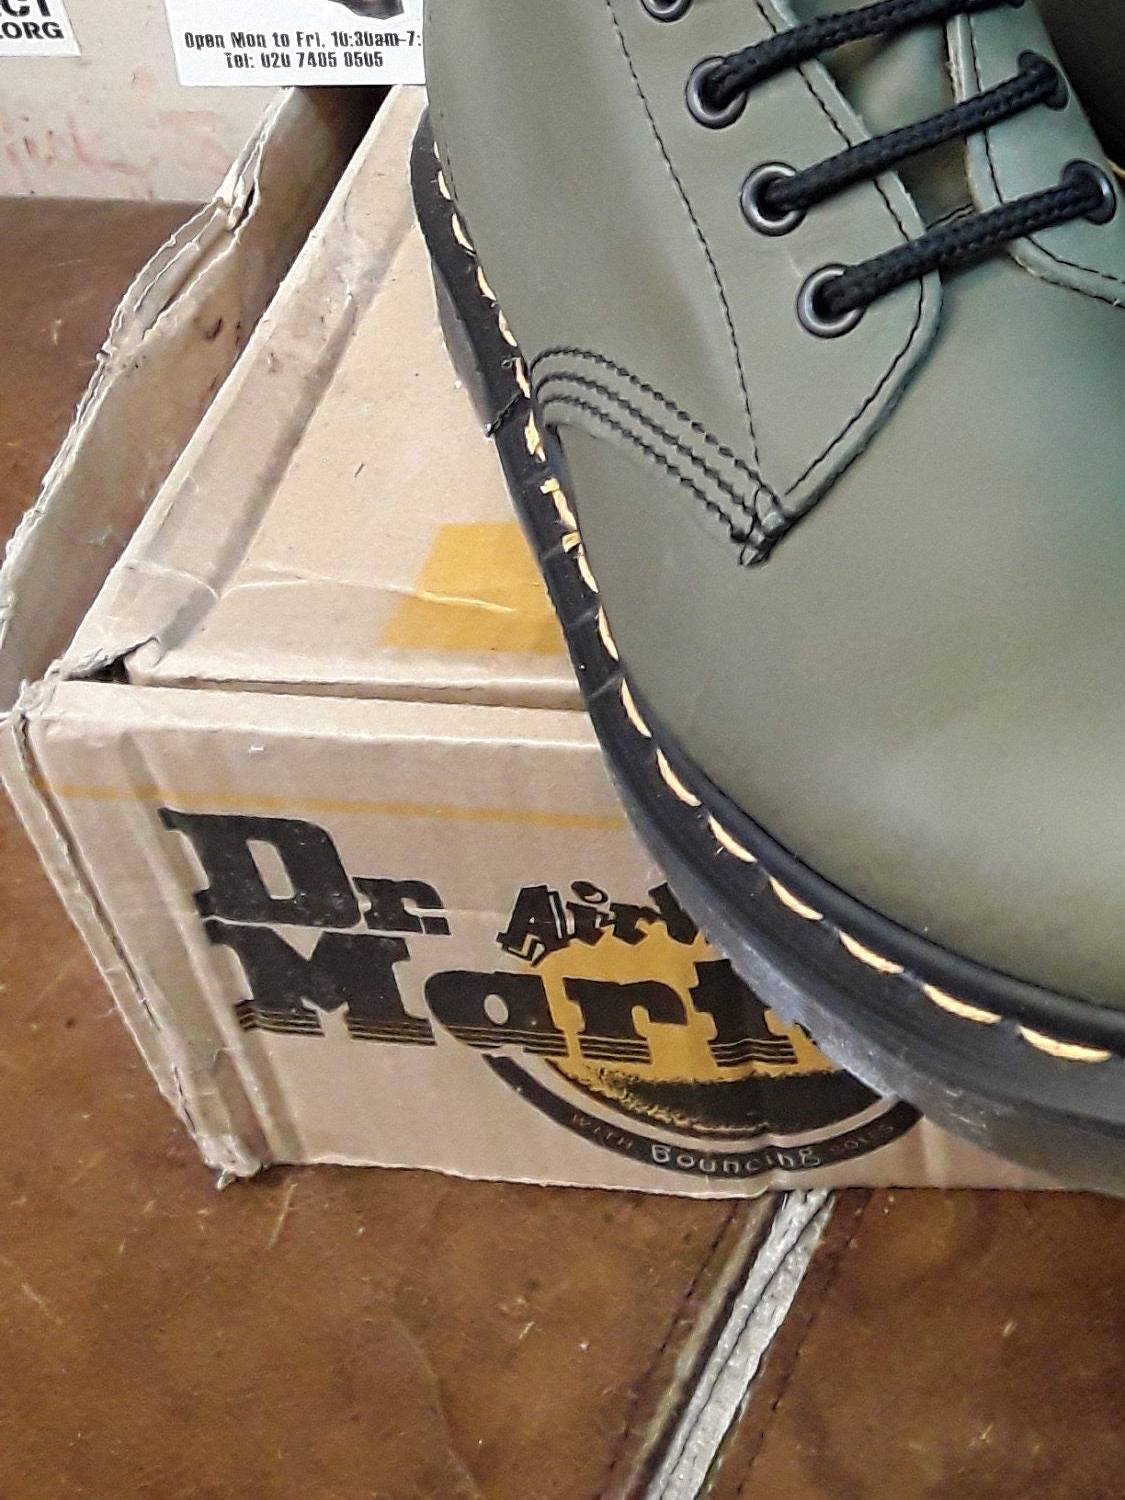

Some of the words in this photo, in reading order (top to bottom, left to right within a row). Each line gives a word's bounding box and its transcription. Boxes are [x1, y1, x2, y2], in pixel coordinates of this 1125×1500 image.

[184, 31, 226, 50] Open
[230, 31, 267, 48] Mon
[271, 32, 291, 48] to
